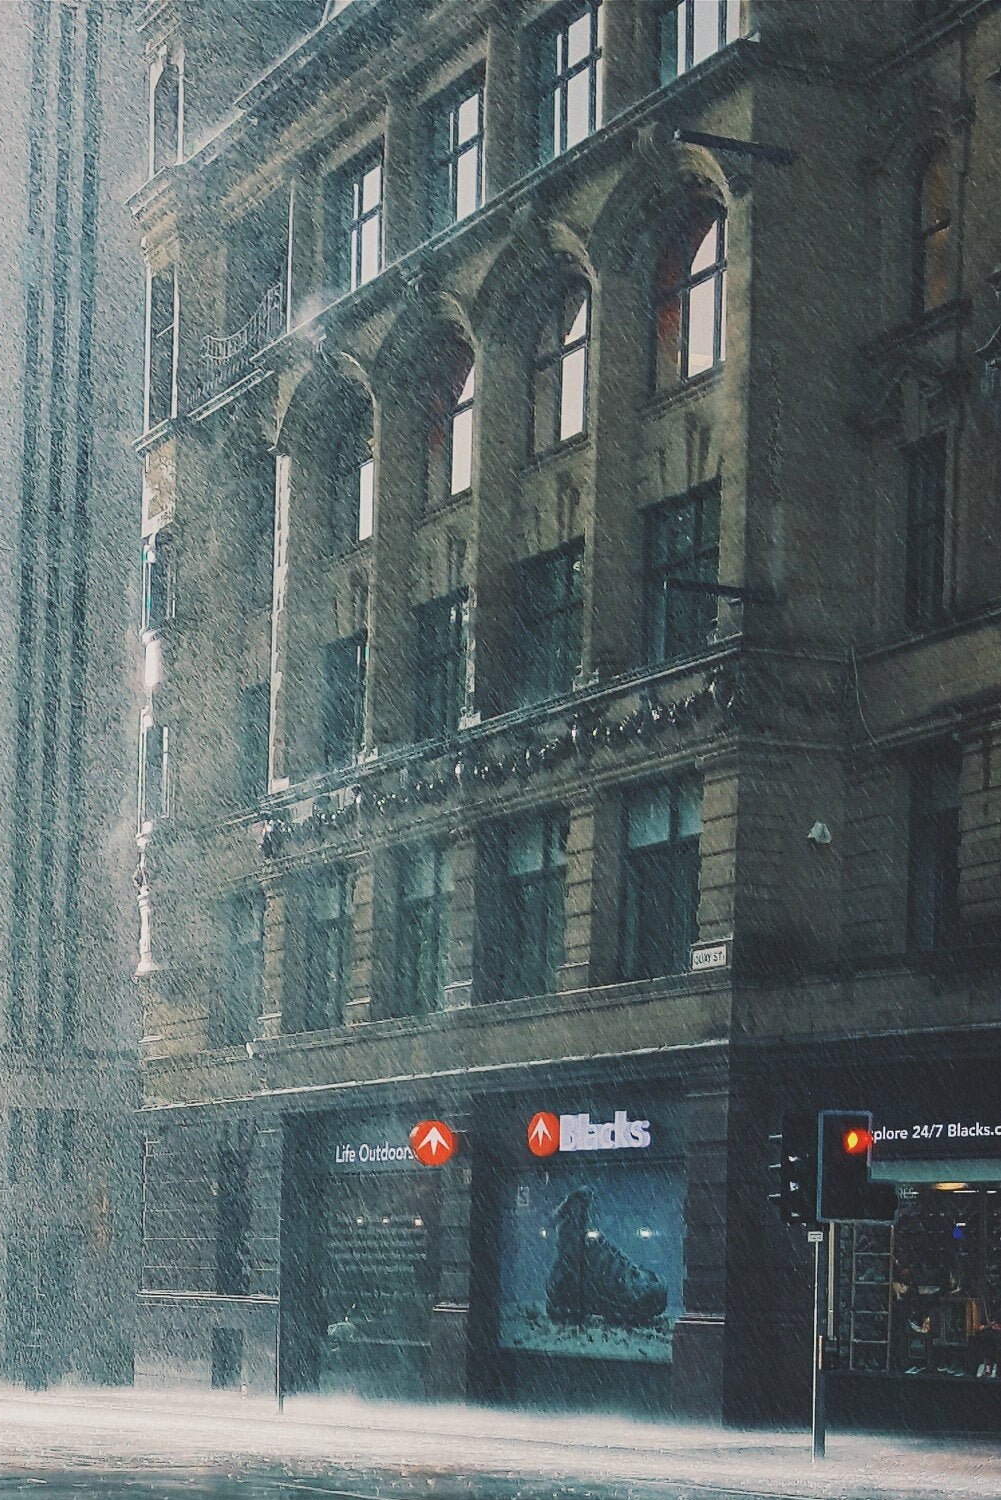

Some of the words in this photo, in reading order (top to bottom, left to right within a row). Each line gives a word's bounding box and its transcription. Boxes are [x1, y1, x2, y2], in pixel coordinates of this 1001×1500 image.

[560, 1110, 651, 1151] Blacks
[872, 1126, 908, 1143] plore
[912, 1124, 943, 1139] 24/7
[335, 1144, 355, 1163] Life
